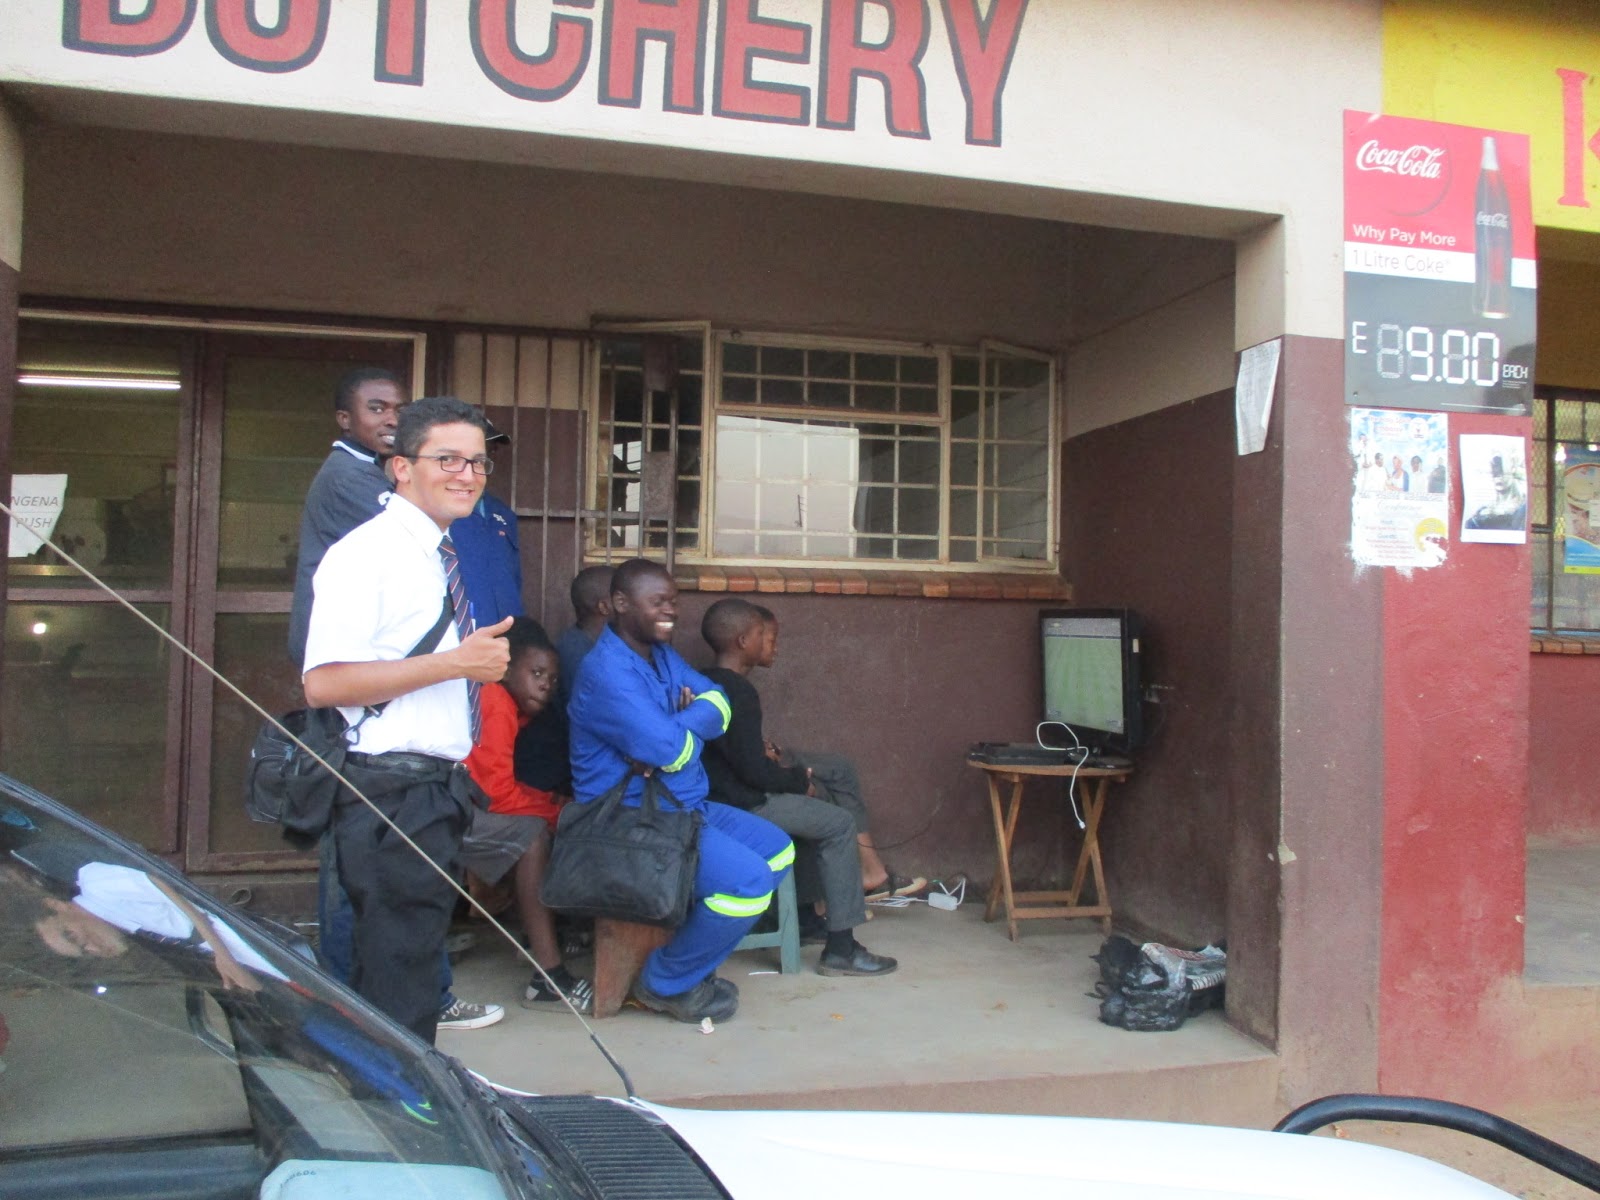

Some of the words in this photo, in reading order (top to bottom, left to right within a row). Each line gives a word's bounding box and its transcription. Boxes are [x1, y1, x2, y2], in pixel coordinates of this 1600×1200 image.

[1352, 224, 1386, 241] Why
[1389, 228, 1416, 244] Pay
[1420, 231, 1456, 246] More
[1353, 249, 1358, 265] 1
[1364, 251, 1399, 269] Litre
[1352, 321, 1367, 354] E
[16, 517, 52, 528] PUSH
